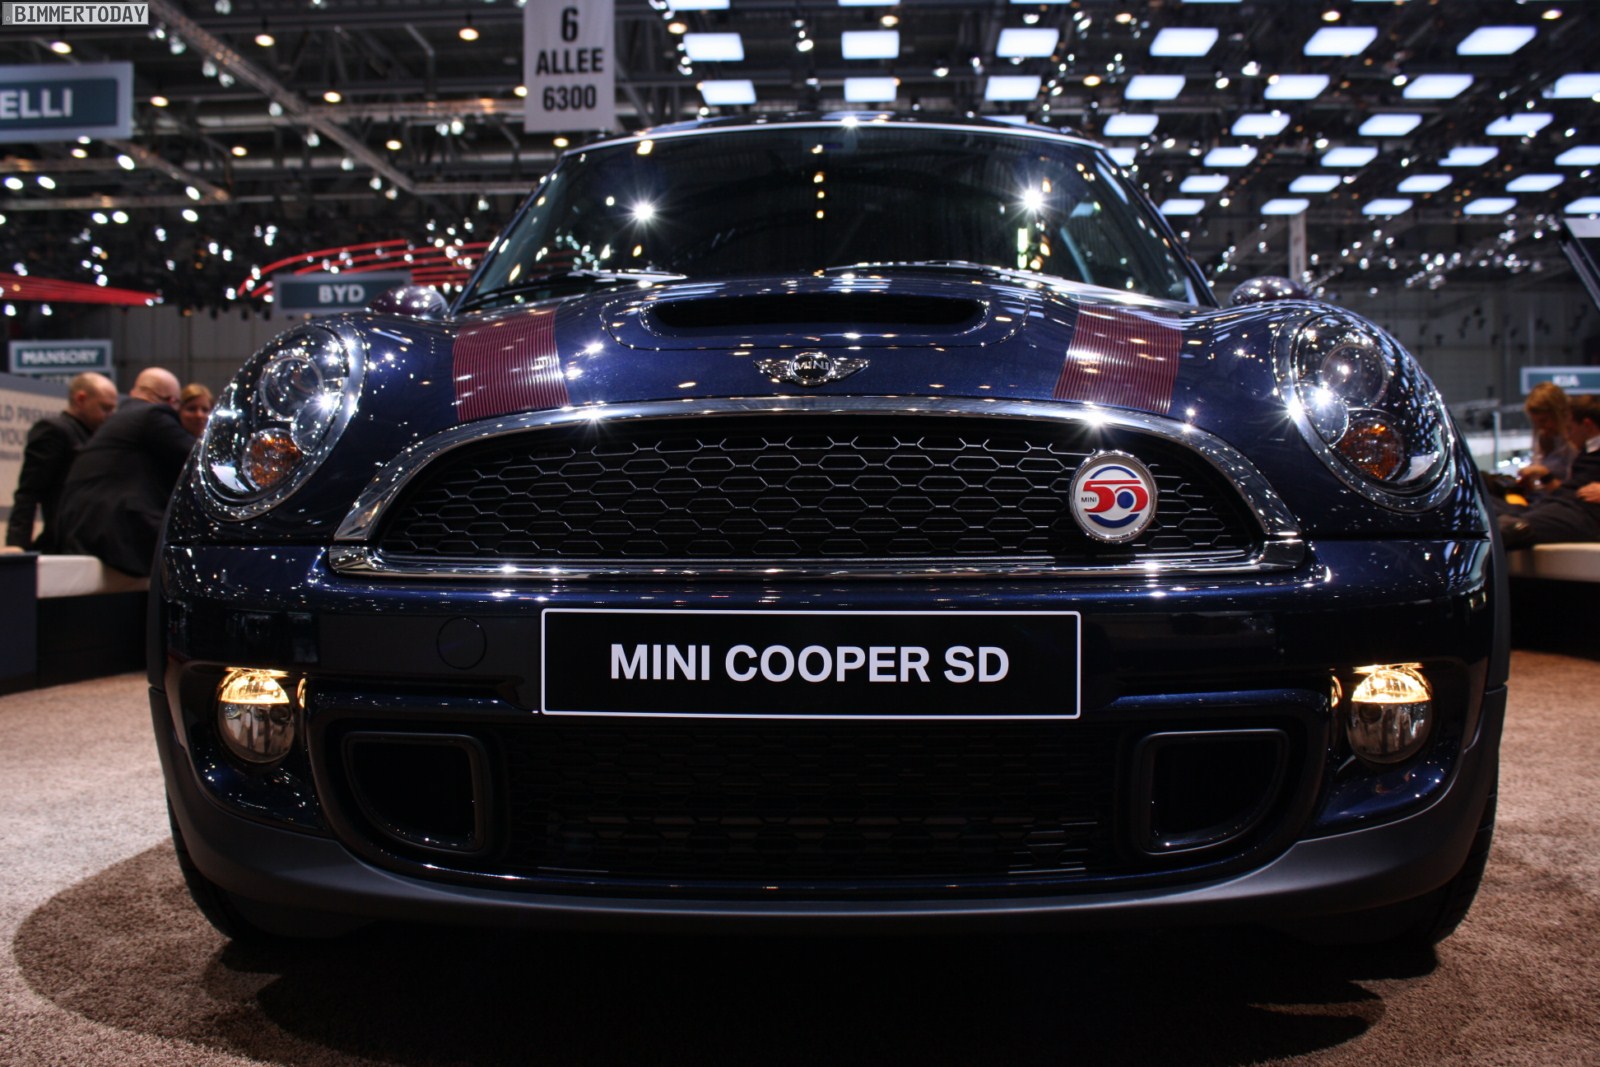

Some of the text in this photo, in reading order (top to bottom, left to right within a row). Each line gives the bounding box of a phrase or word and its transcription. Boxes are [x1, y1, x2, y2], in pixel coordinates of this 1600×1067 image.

[561, 7, 579, 43] 6
[536, 48, 604, 76] ALLEE
[0, 88, 73, 119] ELLI
[543, 84, 597, 112] 6300
[318, 284, 365, 303] BYD
[21, 349, 98, 364] MANSORY
[793, 359, 830, 371] MINI
[1082, 480, 1150, 513] 50
[610, 643, 1010, 683] MINI COOPER SD
